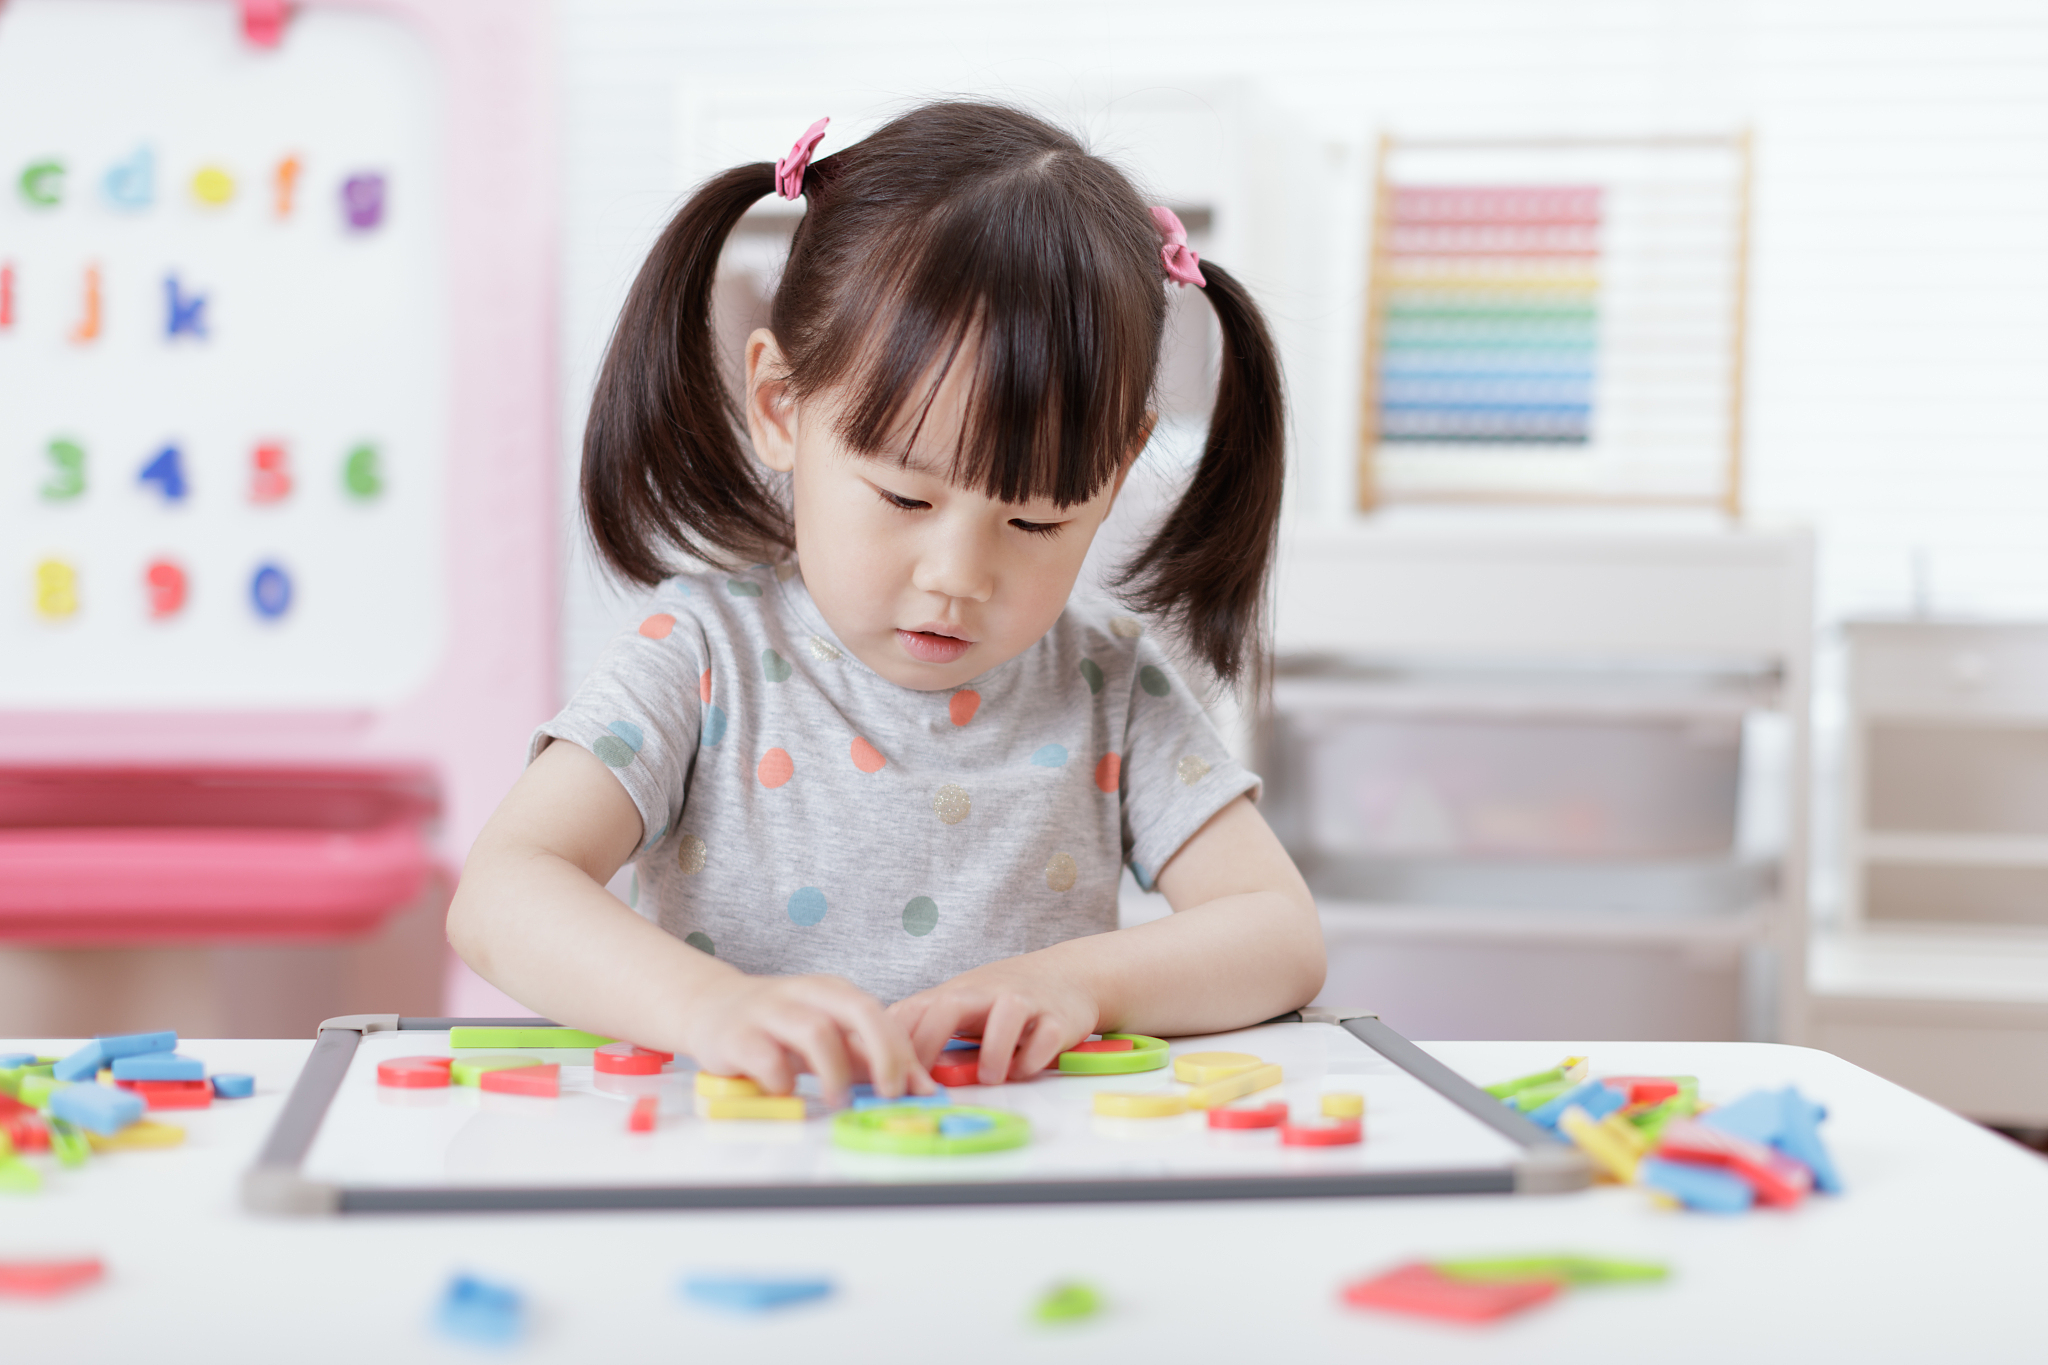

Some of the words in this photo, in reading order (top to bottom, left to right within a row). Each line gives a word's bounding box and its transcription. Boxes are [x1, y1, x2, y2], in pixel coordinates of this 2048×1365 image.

[16, 159, 66, 210] c
[97, 144, 157, 215] d
[272, 155, 303, 218] f
[336, 170, 388, 237] g
[163, 275, 209, 341] k
[40, 436, 90, 505] 3
[136, 442, 191, 507] 4
[248, 439, 296, 508] 5
[339, 442, 386, 505] 6
[33, 557, 81, 623] 8
[142, 556, 193, 624] 9
